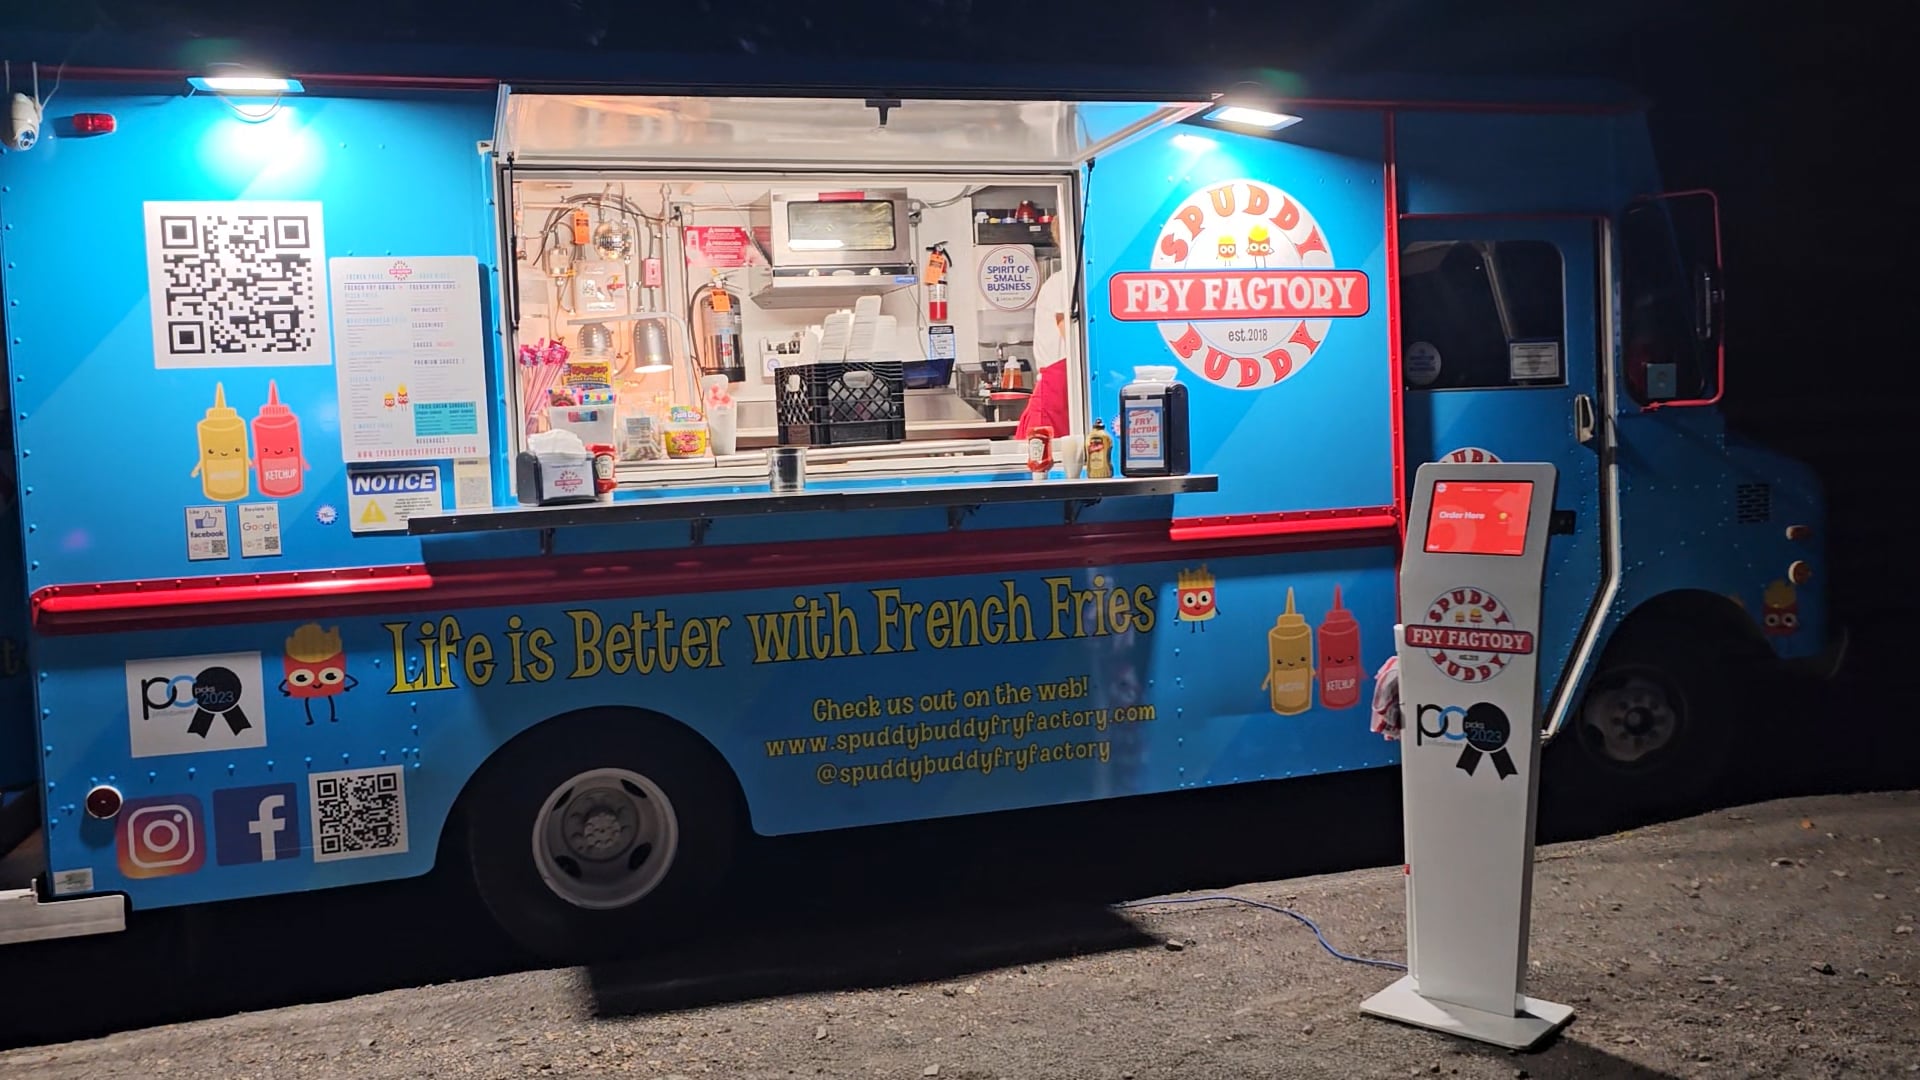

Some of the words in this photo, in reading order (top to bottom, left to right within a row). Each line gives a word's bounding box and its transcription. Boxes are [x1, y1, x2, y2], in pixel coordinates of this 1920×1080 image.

[1161, 184, 1327, 263] SPUDDY
[1003, 255, 1014, 264] 76
[987, 265, 1015, 274] SPIRIT
[1017, 265, 1030, 273] OF
[993, 274, 1024, 282] SMALL
[987, 282, 1031, 291] BUSINESS
[1123, 279, 1195, 312] FRY
[1201, 277, 1357, 311] FACTORY
[1228, 328, 1268, 342] est.2018
[1170, 320, 1321, 388] BUDDY
[1135, 417, 1152, 426] FRY
[265, 468, 297, 480] KETCHUP
[355, 472, 435, 492] NOTICE
[1439, 511, 1463, 519] Order
[242, 521, 278, 532] Google
[190, 530, 224, 538] facebook
[1429, 589, 1510, 626] SPUDDY
[381, 615, 497, 695] Life
[505, 615, 556, 685] is
[563, 608, 731, 682] Better
[744, 592, 864, 664] with
[869, 578, 1036, 655] French
[1041, 575, 1157, 641] Fries
[1412, 628, 1447, 645] FRY
[1447, 630, 1525, 651] FACTORY
[201, 691, 235, 705] 2023
[812, 696, 881, 723] Check
[887, 697, 914, 716] us
[919, 689, 957, 713] out
[963, 691, 991, 708] on
[994, 682, 1032, 706] the
[1037, 676, 1089, 702] web!
[765, 703, 1157, 758] www.spuddybuddyfryfactory.com
[1470, 729, 1502, 743] 2023
[815, 738, 1112, 787] @spuddybuddyfryfactory
